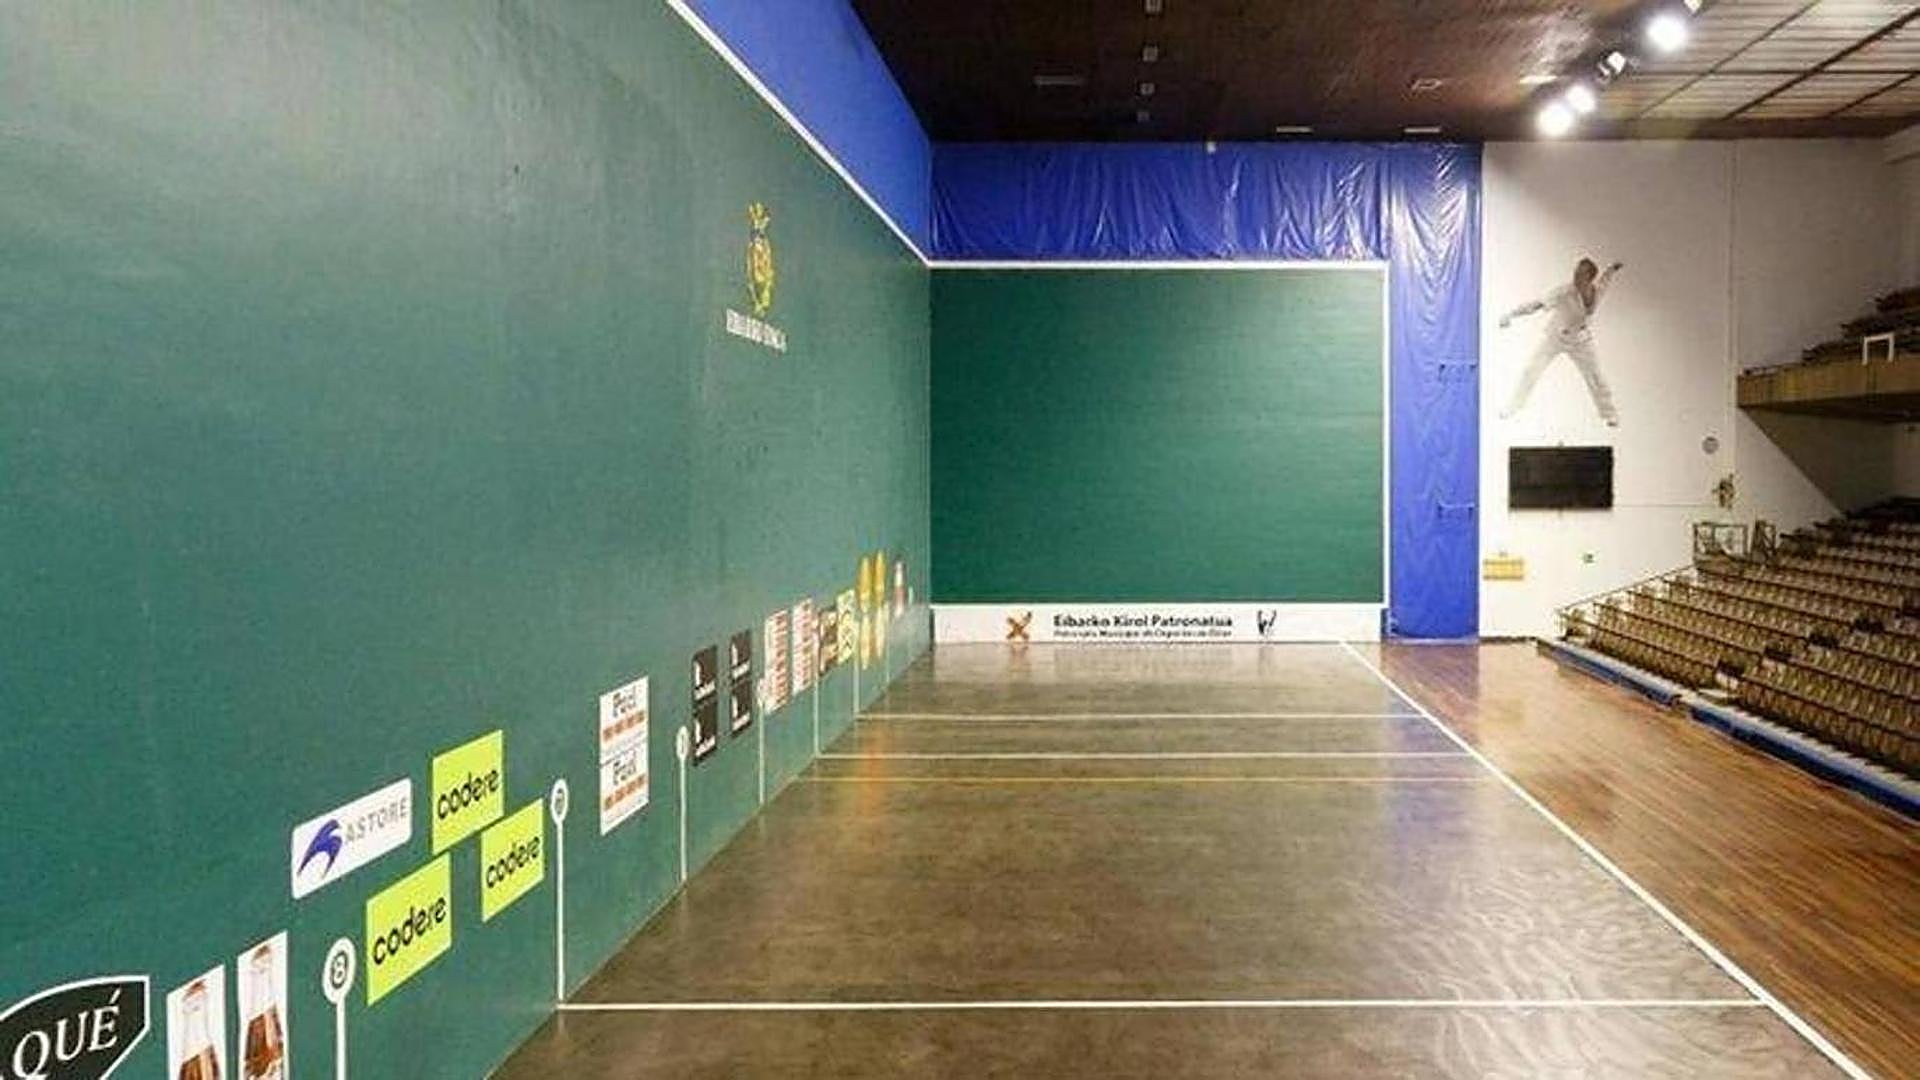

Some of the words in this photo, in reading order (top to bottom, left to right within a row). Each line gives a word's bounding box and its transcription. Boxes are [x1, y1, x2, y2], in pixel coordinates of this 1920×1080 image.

[1053, 614, 1110, 627] Eibarko
[1113, 614, 1148, 627] Kirol
[1151, 614, 1233, 627] Patronatua
[345, 797, 407, 844] ASTORE
[437, 769, 500, 820] codere
[485, 836, 540, 889] codere
[372, 897, 447, 966] codere
[12, 988, 121, 1080] QUÉ
